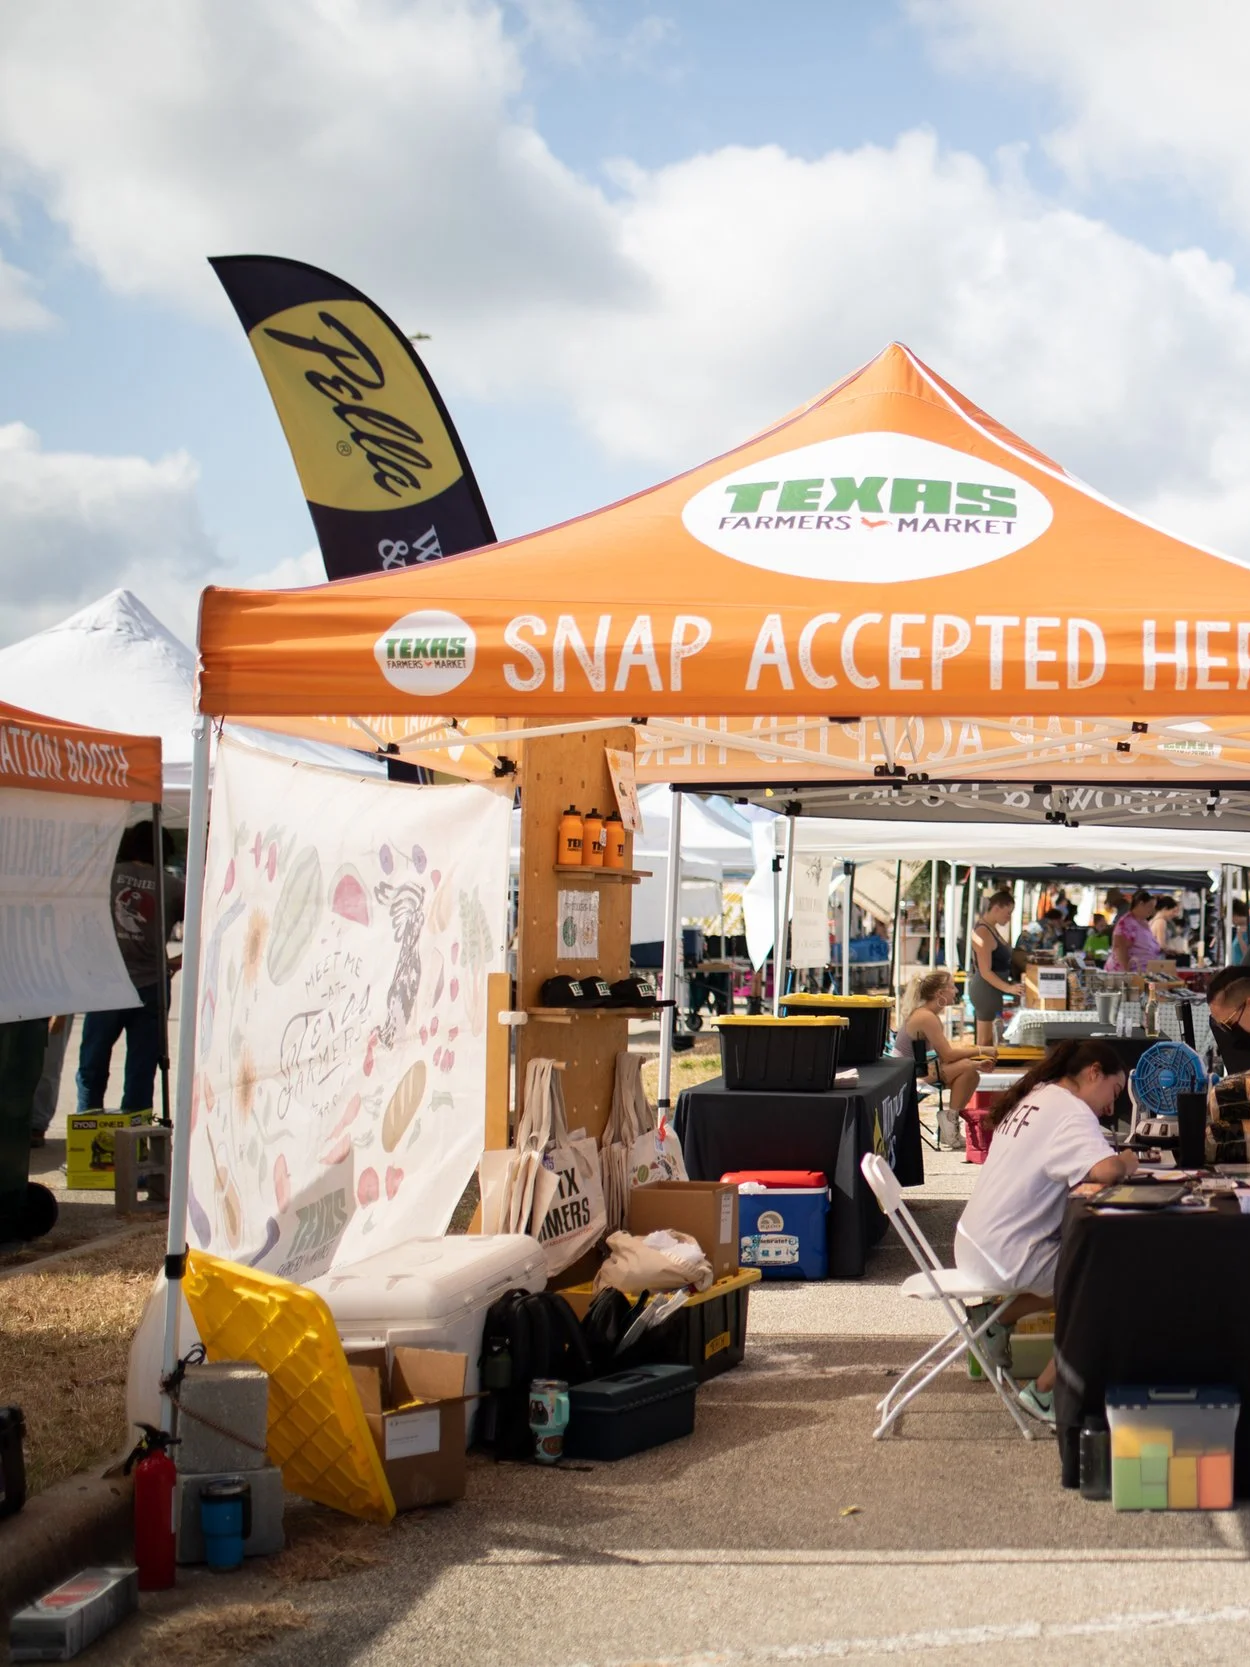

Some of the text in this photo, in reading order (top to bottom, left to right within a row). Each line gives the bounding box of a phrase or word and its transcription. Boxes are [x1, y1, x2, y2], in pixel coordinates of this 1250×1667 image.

[263, 311, 433, 498] Pella
[724, 476, 1017, 518] TEXAS
[718, 515, 1017, 535] FARMERS MARKET
[385, 637, 467, 659] TEXAS
[386, 659, 467, 669] FARMERS MARKET
[503, 614, 712, 693] SNAP
[745, 612, 1106, 692] ACCEPTED
[64, 737, 129, 788] BOOTH
[305, 951, 363, 995] MEET ME
[73, 1121, 97, 1129] RYOBI
[556, 1167, 580, 1200] TX
[286, 1188, 348, 1259] TEXAS
[540, 1196, 591, 1243] MERS
